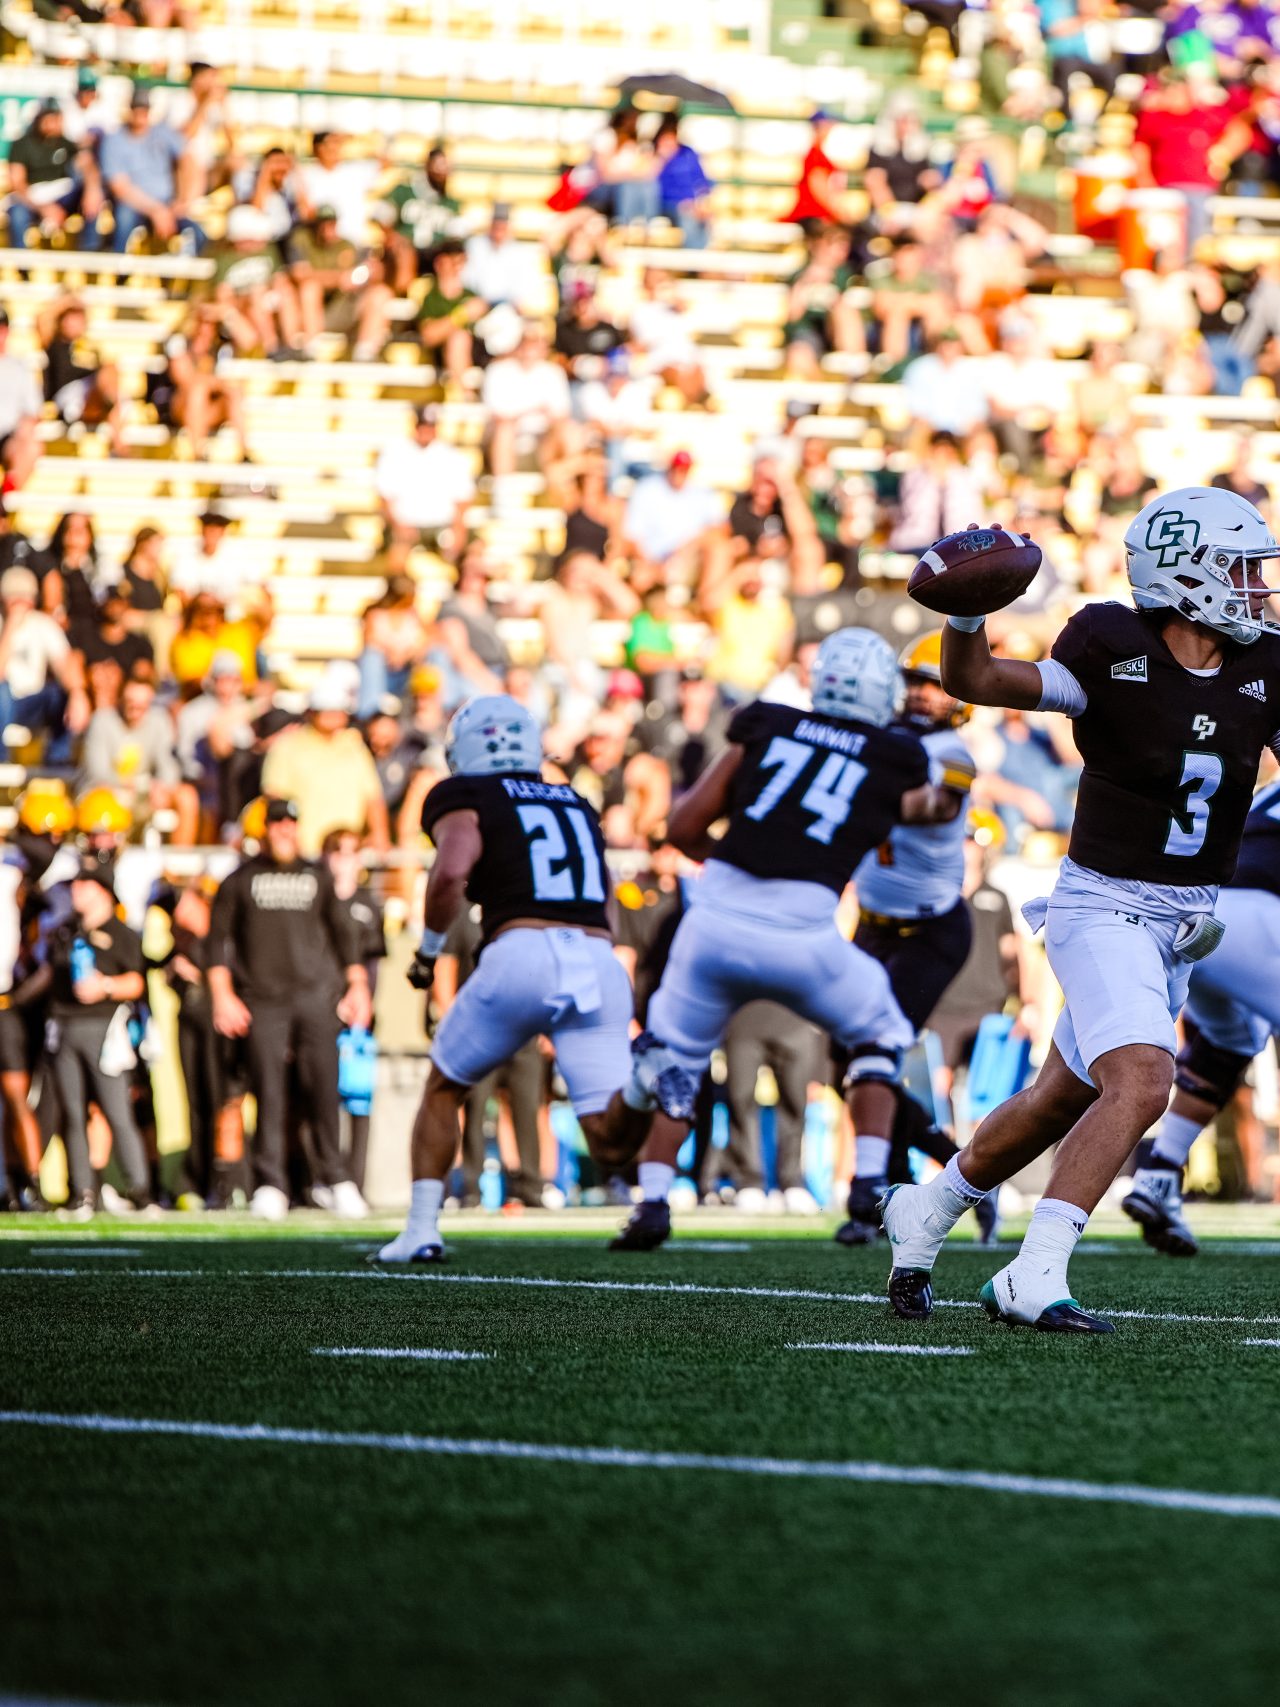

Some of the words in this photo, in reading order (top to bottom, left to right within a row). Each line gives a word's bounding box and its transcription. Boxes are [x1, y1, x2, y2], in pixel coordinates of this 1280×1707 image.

[1238, 686, 1267, 703] adidas
[1191, 713, 1218, 740] CP
[501, 778, 578, 803] FLETCHER
[744, 735, 868, 845] 74
[1163, 749, 1225, 857] 3
[515, 803, 606, 902] 21
